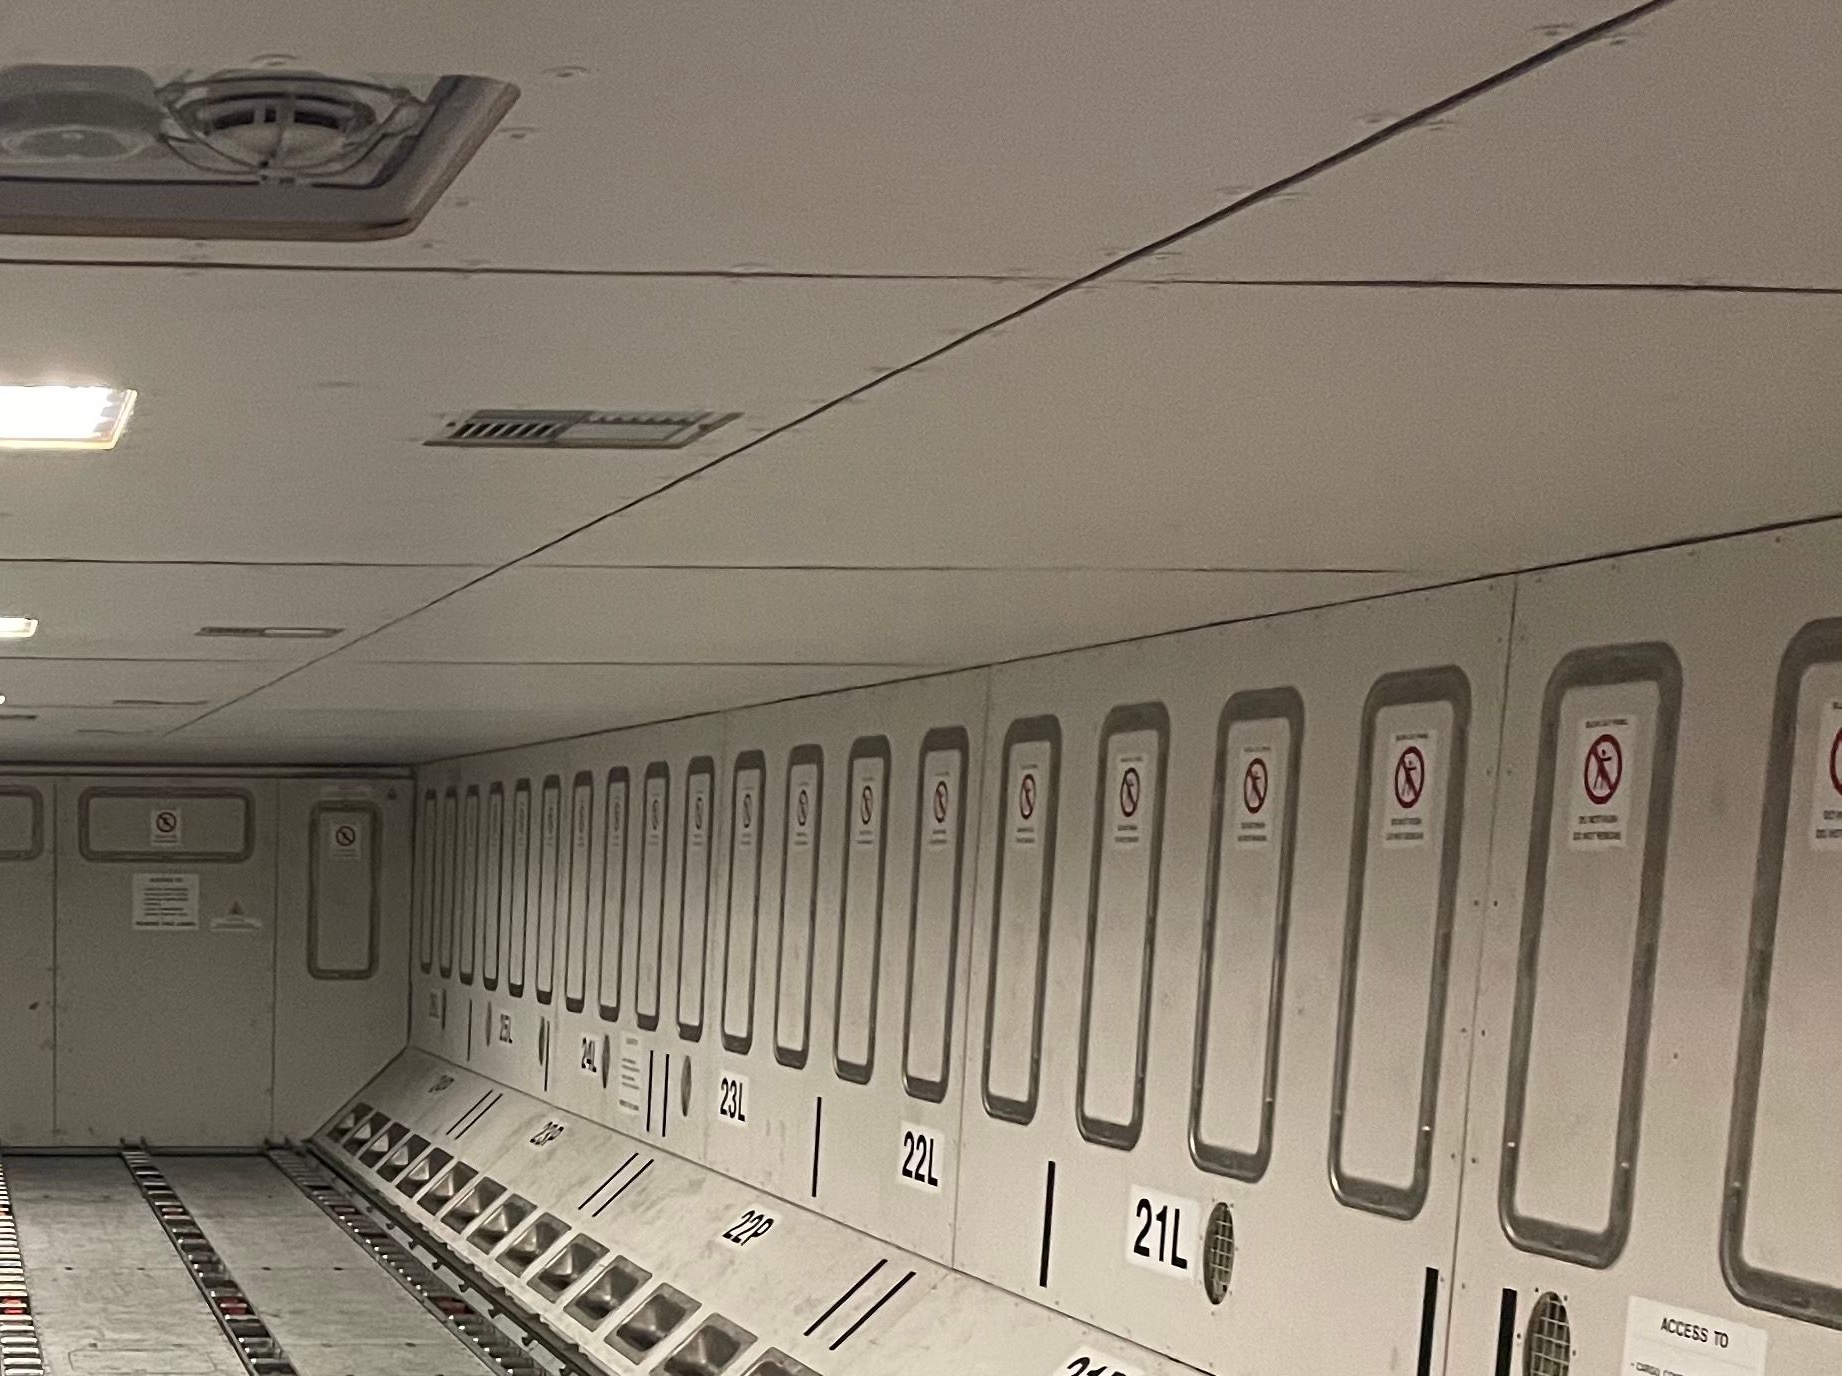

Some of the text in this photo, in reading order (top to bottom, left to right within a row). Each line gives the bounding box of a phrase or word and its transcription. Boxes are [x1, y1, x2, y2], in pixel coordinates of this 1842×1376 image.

[720, 1077, 746, 1122] 23L
[902, 1131, 938, 1187] 22L
[722, 1210, 774, 1246] 22P
[1133, 1198, 1188, 1270] 21L
[1660, 1317, 1729, 1349] ACCESS TO
